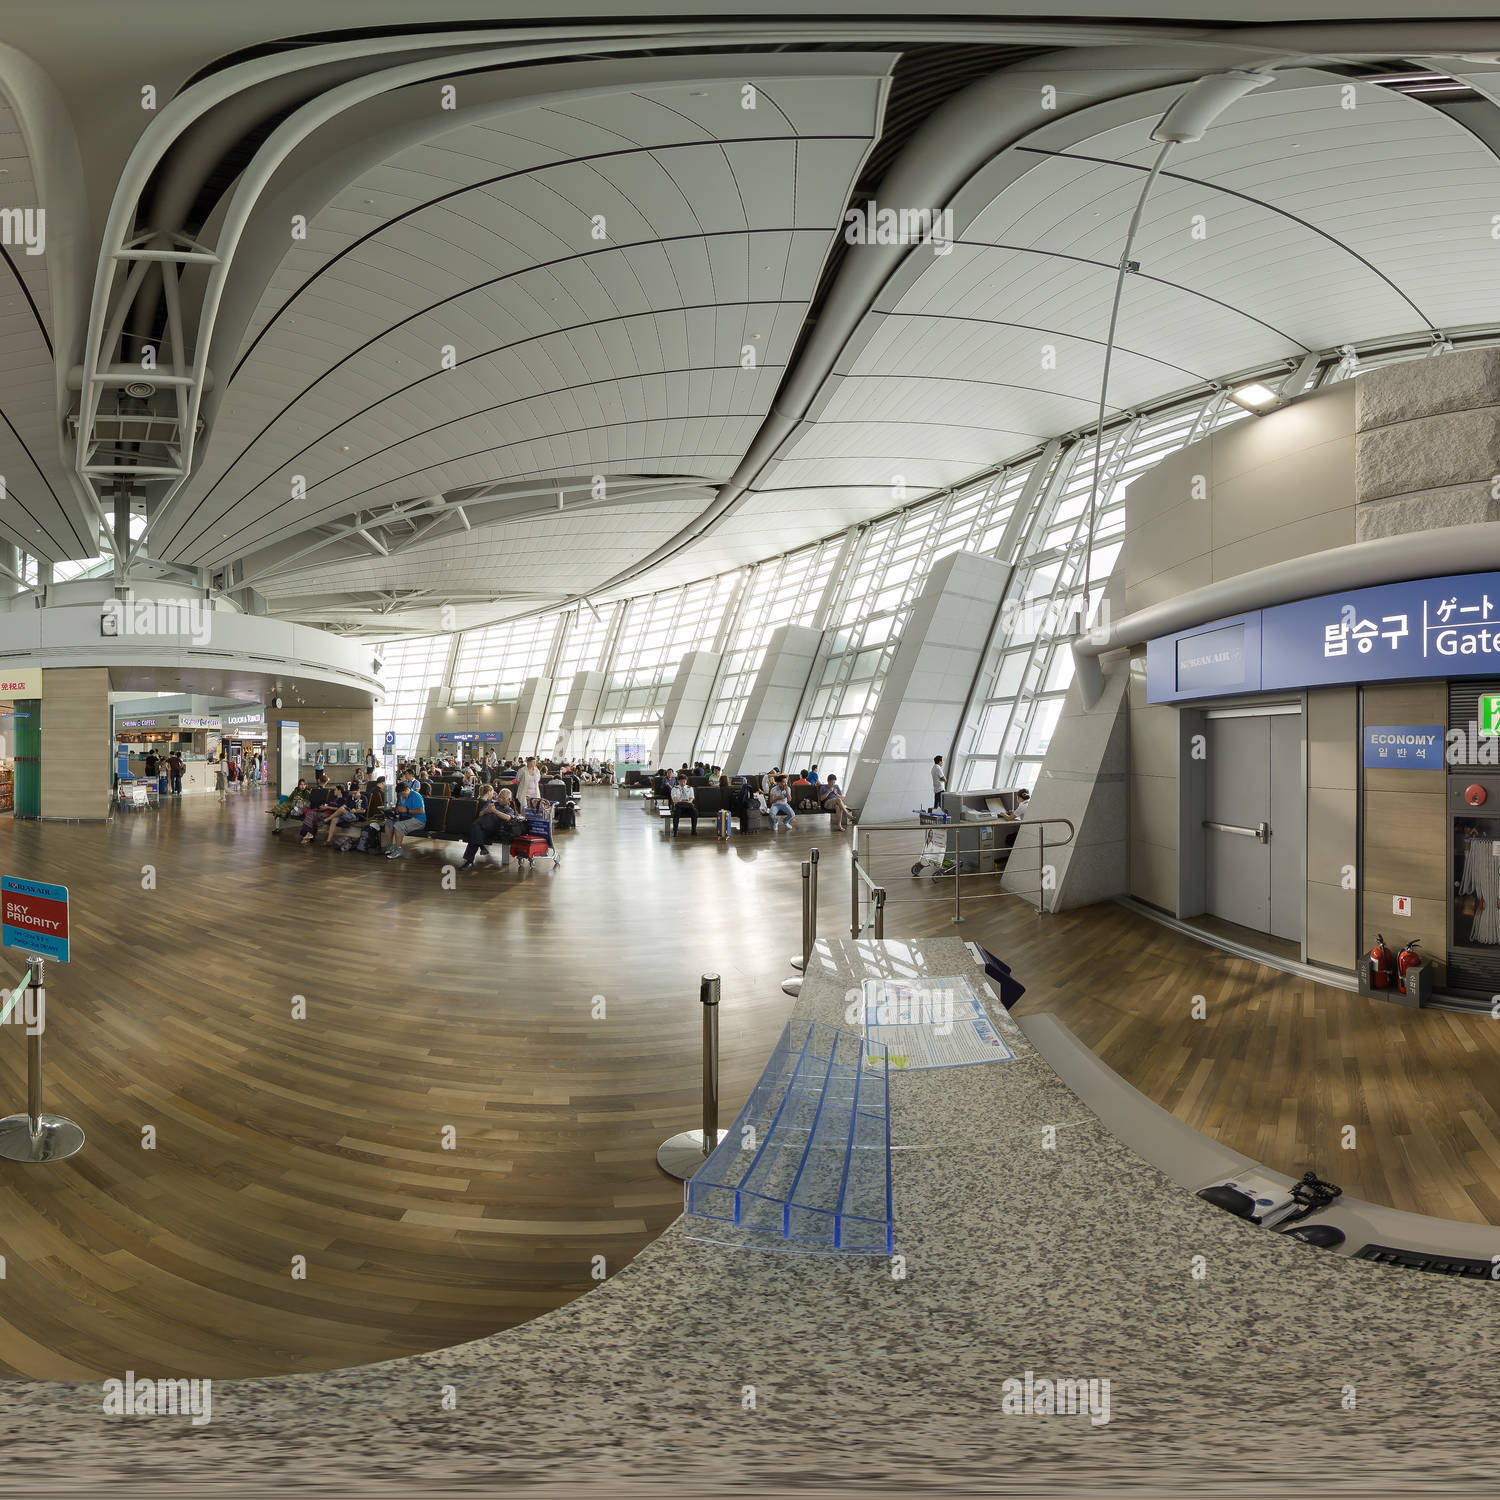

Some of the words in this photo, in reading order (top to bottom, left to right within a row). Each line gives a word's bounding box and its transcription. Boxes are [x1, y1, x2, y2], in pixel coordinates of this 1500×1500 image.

[1324, 614, 1409, 658] 탑승구
[1371, 734, 1435, 745] ECONOMY
[7, 902, 29, 914] SKY
[7, 911, 60, 930] PRIORITY
